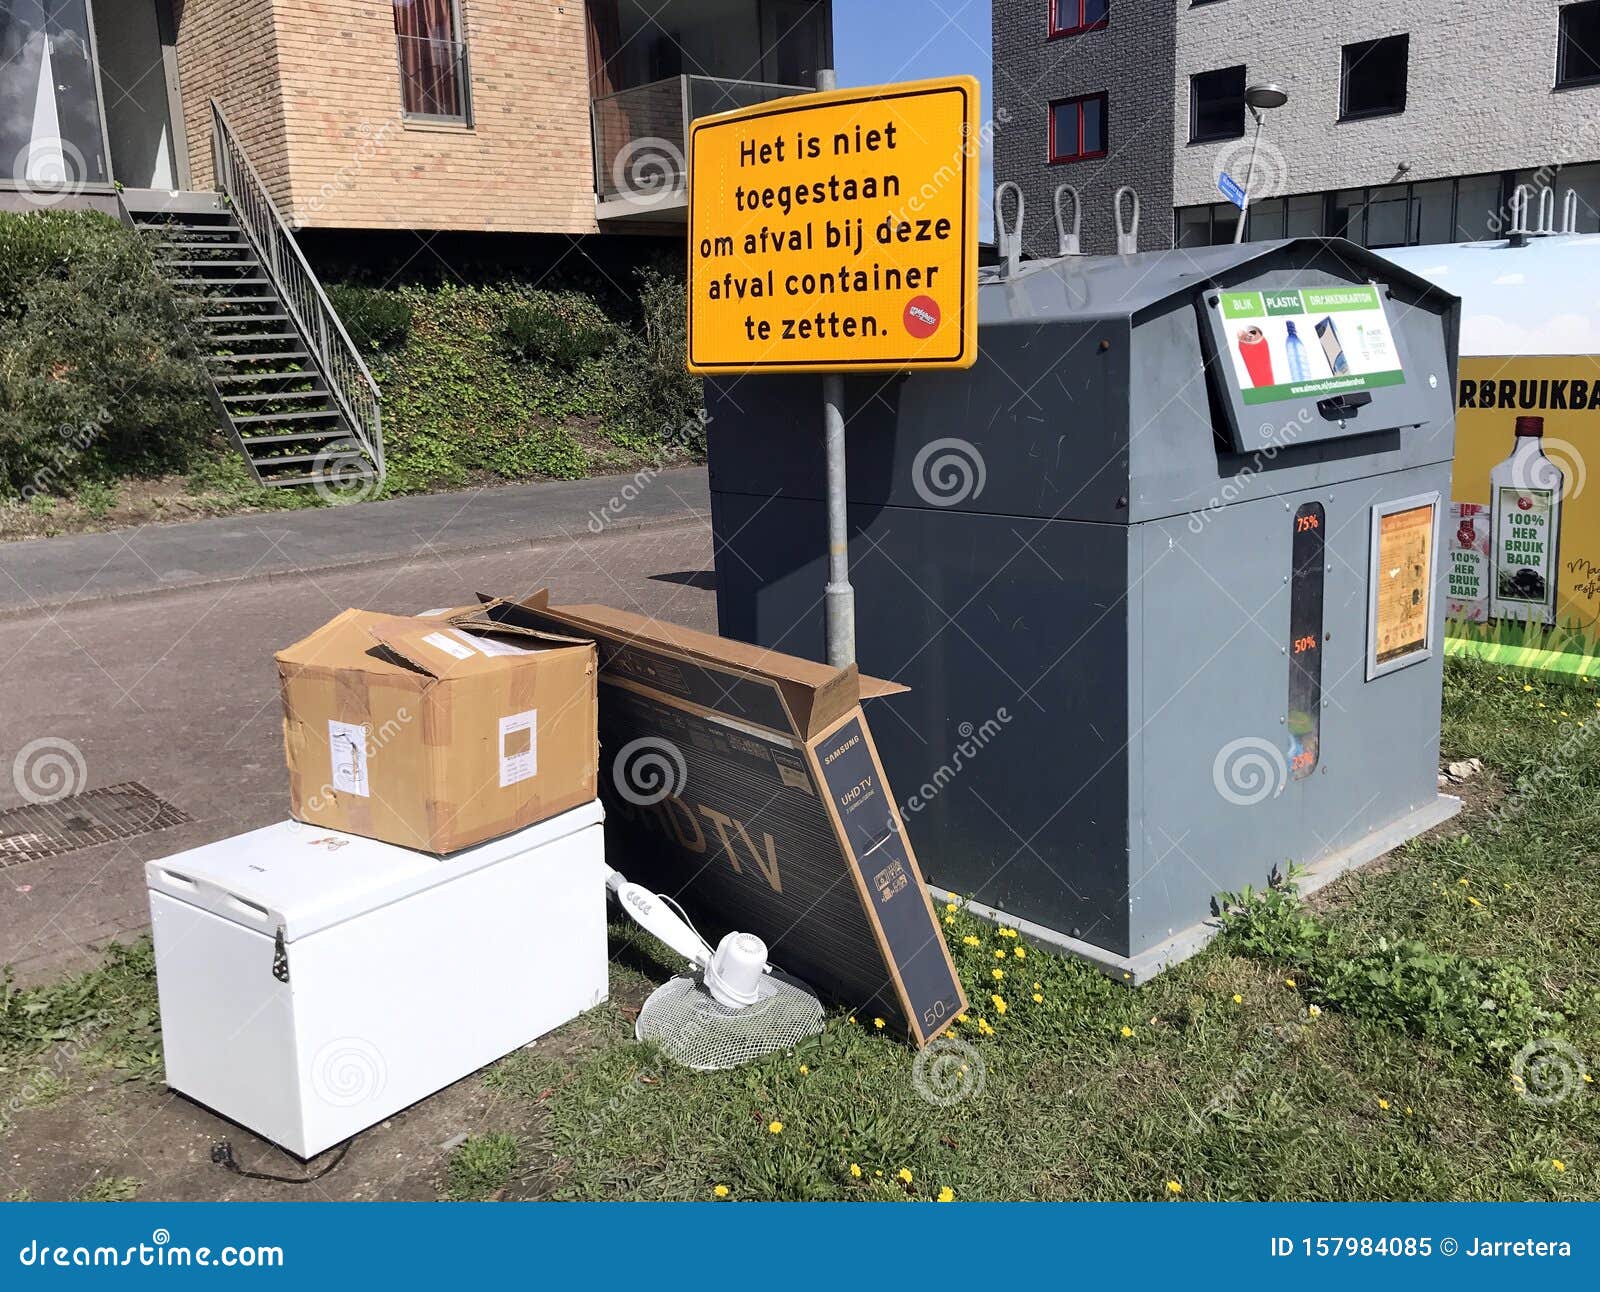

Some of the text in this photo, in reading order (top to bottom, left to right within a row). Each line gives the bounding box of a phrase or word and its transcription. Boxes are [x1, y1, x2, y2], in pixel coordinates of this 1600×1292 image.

[740, 121, 897, 168] Het is niet
[735, 174, 900, 215] toegestaan
[700, 216, 951, 258] om afval bij deze
[709, 263, 939, 300] afval container
[1232, 298, 1254, 311] BLIK
[1266, 295, 1300, 309] PLASTIC
[745, 315, 771, 340] te
[782, 312, 888, 340] zetten.
[1297, 514, 1318, 532] 75%
[1507, 513, 1544, 526] 100%
[1512, 527, 1537, 540] HER
[1505, 539, 1544, 553] BRUIK
[1450, 552, 1480, 564] 100%
[1507, 553, 1541, 566] BAAR
[1454, 564, 1475, 575] HER
[1449, 574, 1480, 587] BRUIK
[1450, 585, 1478, 597] BAAR
[1294, 636, 1316, 654] 50%
[824, 735, 860, 765] SAMSUNG
[1292, 752, 1313, 770] 25%
[841, 786, 861, 806] UHD
[859, 776, 872, 791] TV
[698, 804, 783, 893] TV
[924, 1001, 945, 1027] 50
